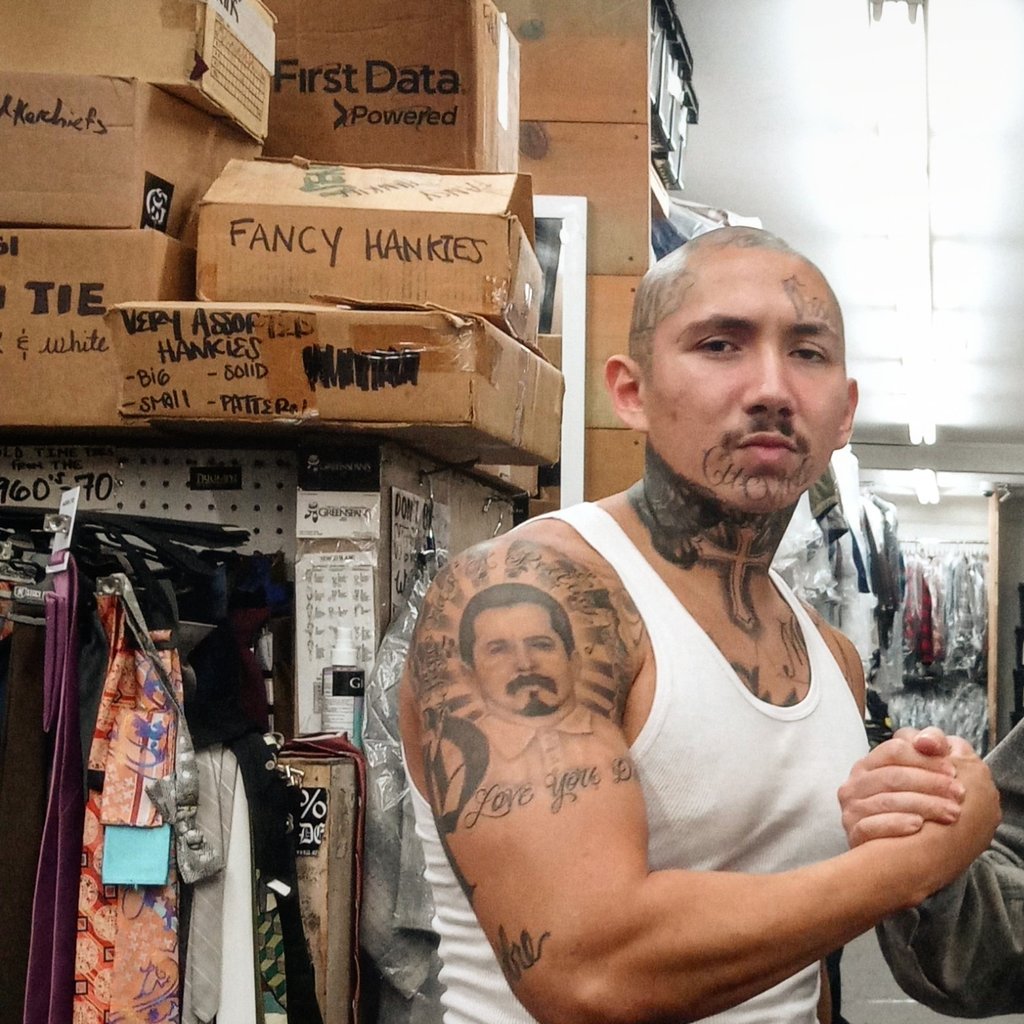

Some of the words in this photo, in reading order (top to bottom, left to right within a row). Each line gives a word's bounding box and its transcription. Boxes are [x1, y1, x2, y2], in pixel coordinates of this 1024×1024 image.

[273, 58, 358, 95] First
[365, 59, 460, 95] Data
[351, 105, 458, 127] Powered
[229, 217, 343, 268] FANCY
[365, 227, 487, 264] HANKIES
[24, 281, 107, 316] TIE
[119, 309, 182, 340] VERY
[38, 329, 110, 354] white
[50, 460, 83, 470] THE
[464, 782, 534, 829] Love
[545, 766, 602, 814] You
